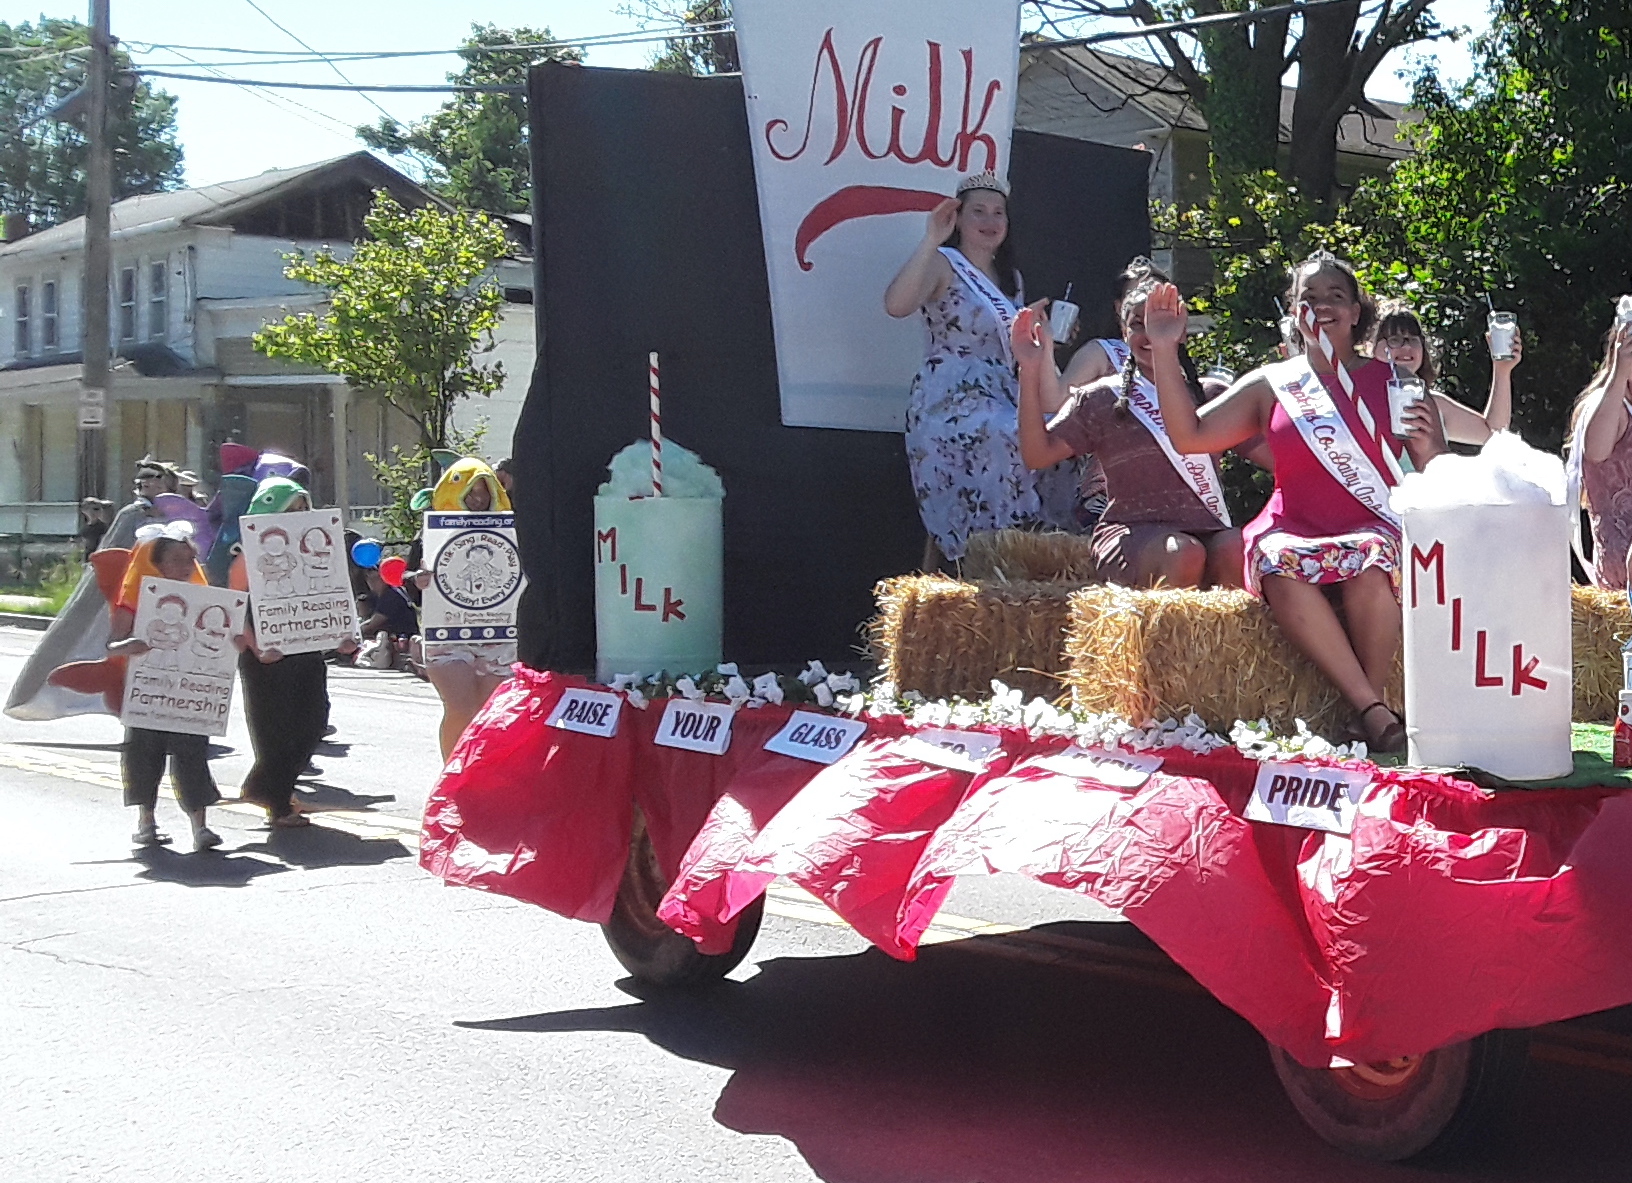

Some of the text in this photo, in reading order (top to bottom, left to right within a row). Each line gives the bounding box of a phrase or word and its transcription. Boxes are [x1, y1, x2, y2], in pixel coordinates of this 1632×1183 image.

[766, 27, 1001, 172] Milk
[1328, 452, 1362, 488] Dairy
[439, 516, 515, 528] familyreading.or
[480, 534, 504, 549] Read
[257, 598, 349, 617] Family Reading
[260, 612, 352, 636] Partnership
[134, 670, 230, 700] Family Reading
[130, 687, 228, 719] Partnership
[562, 699, 614, 727] RAISE
[670, 710, 722, 742] YOUR
[788, 722, 847, 750] GLASS
[1266, 774, 1350, 813] PRIDE
